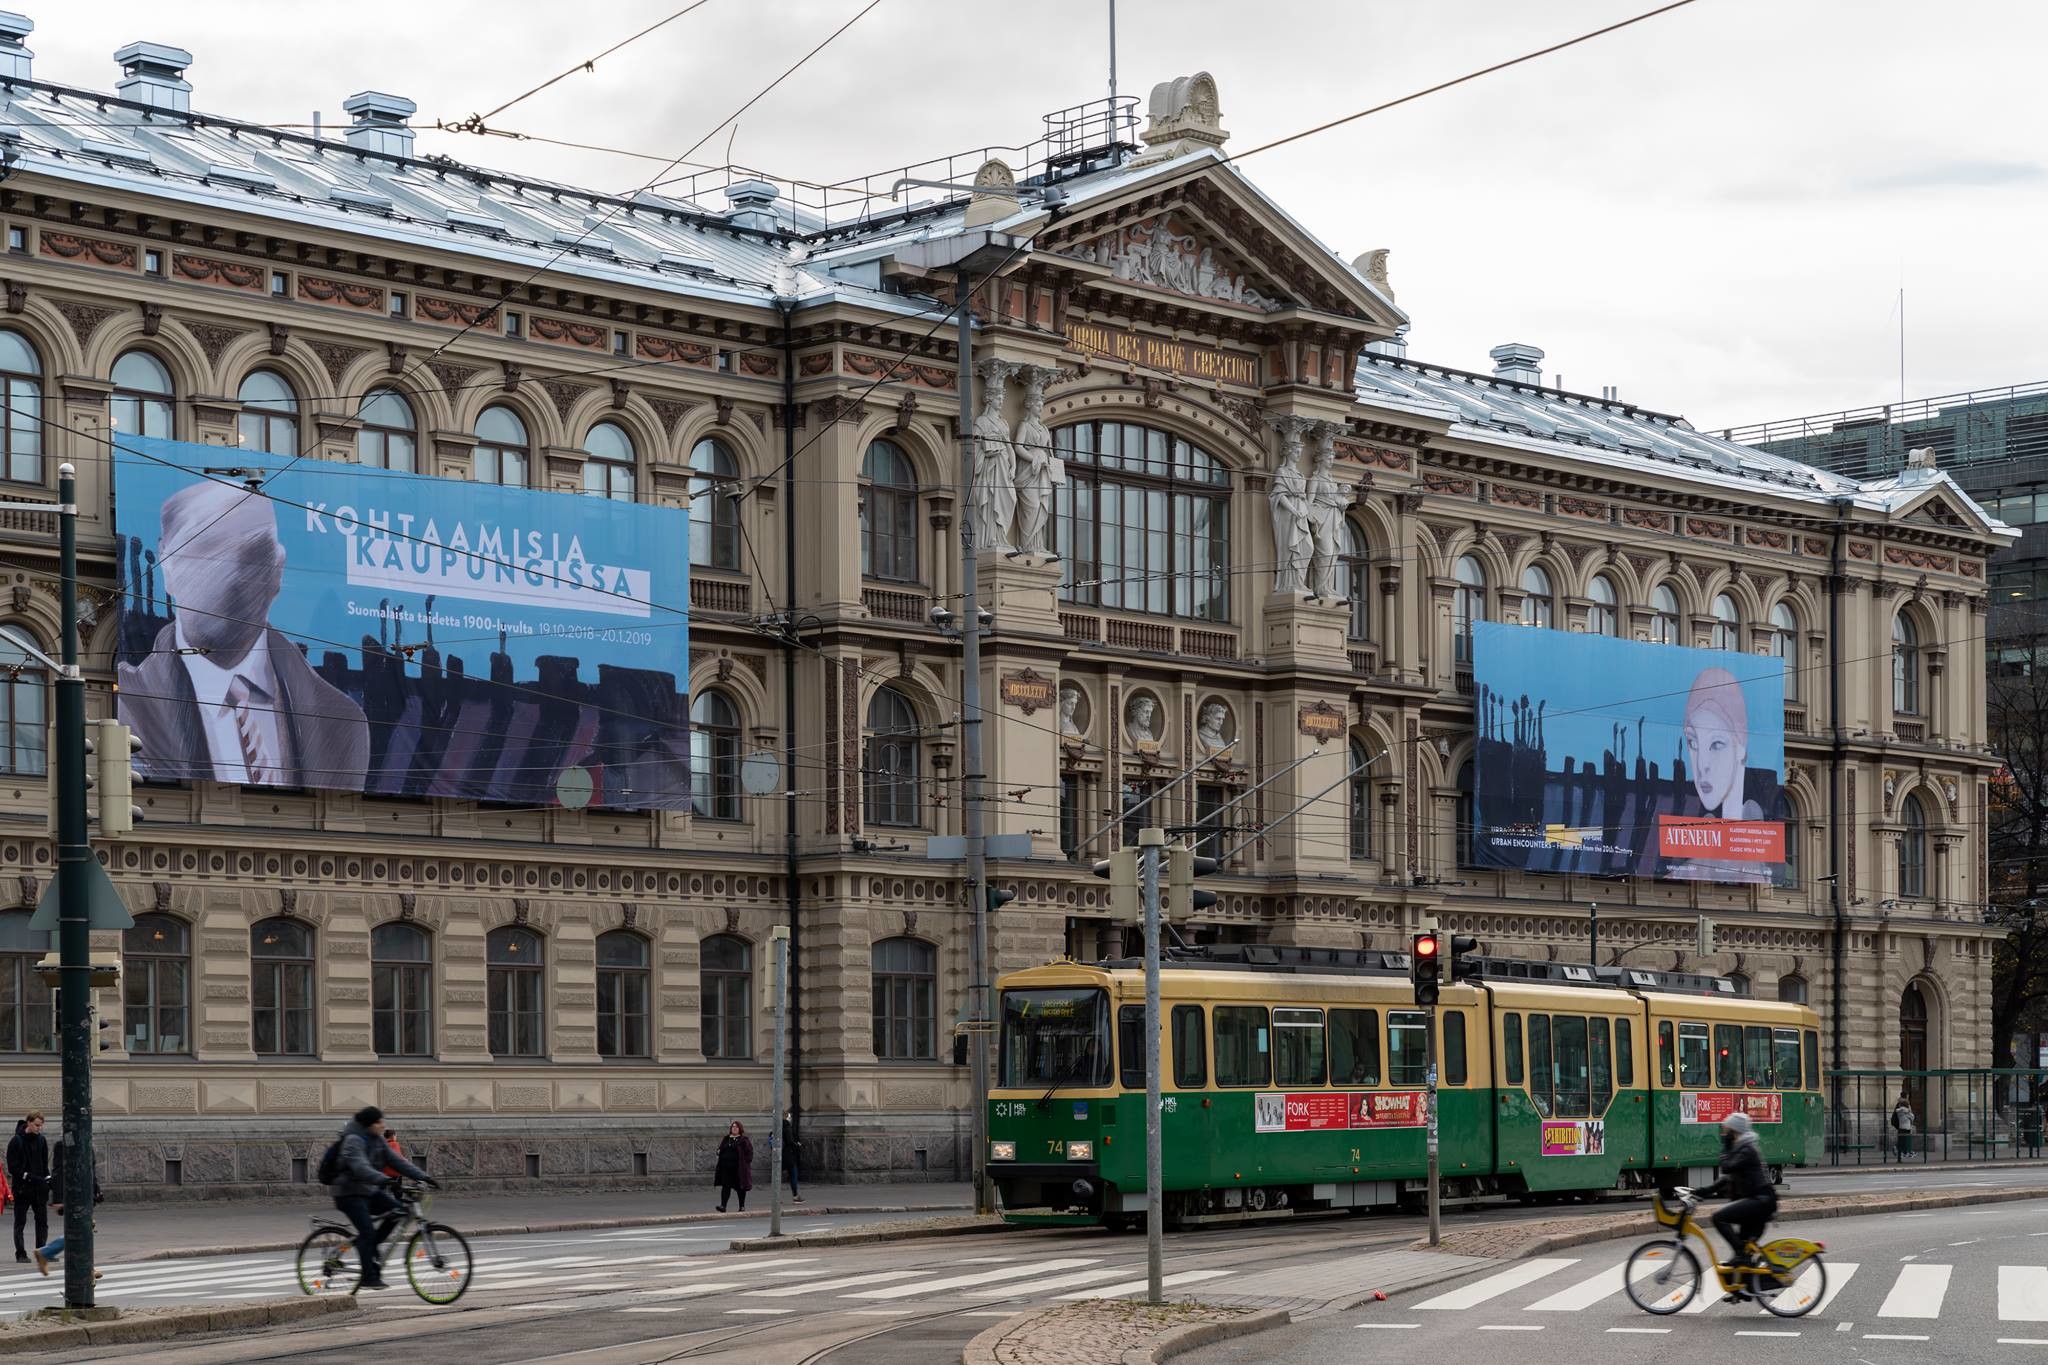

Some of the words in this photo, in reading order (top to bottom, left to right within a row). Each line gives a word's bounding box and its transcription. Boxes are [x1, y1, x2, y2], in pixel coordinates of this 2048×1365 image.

[1064, 323, 1109, 356] CORDIA
[1116, 333, 1140, 361] RES
[306, 500, 587, 564] KOHTAAMISIA
[356, 536, 633, 597] KAUPUNGISSA
[347, 601, 415, 622] Suomalaista
[417, 611, 461, 628] taidetta
[463, 615, 533, 635] 1900-luvulta
[1491, 837, 1512, 847] URBAN
[1513, 839, 1552, 849] ENCOUNTERS
[1665, 828, 1722, 847] ATENEUM
[1287, 1101, 1310, 1116] FORK
[1047, 1140, 1063, 1155] 74
[1351, 1148, 1360, 1162] 74
